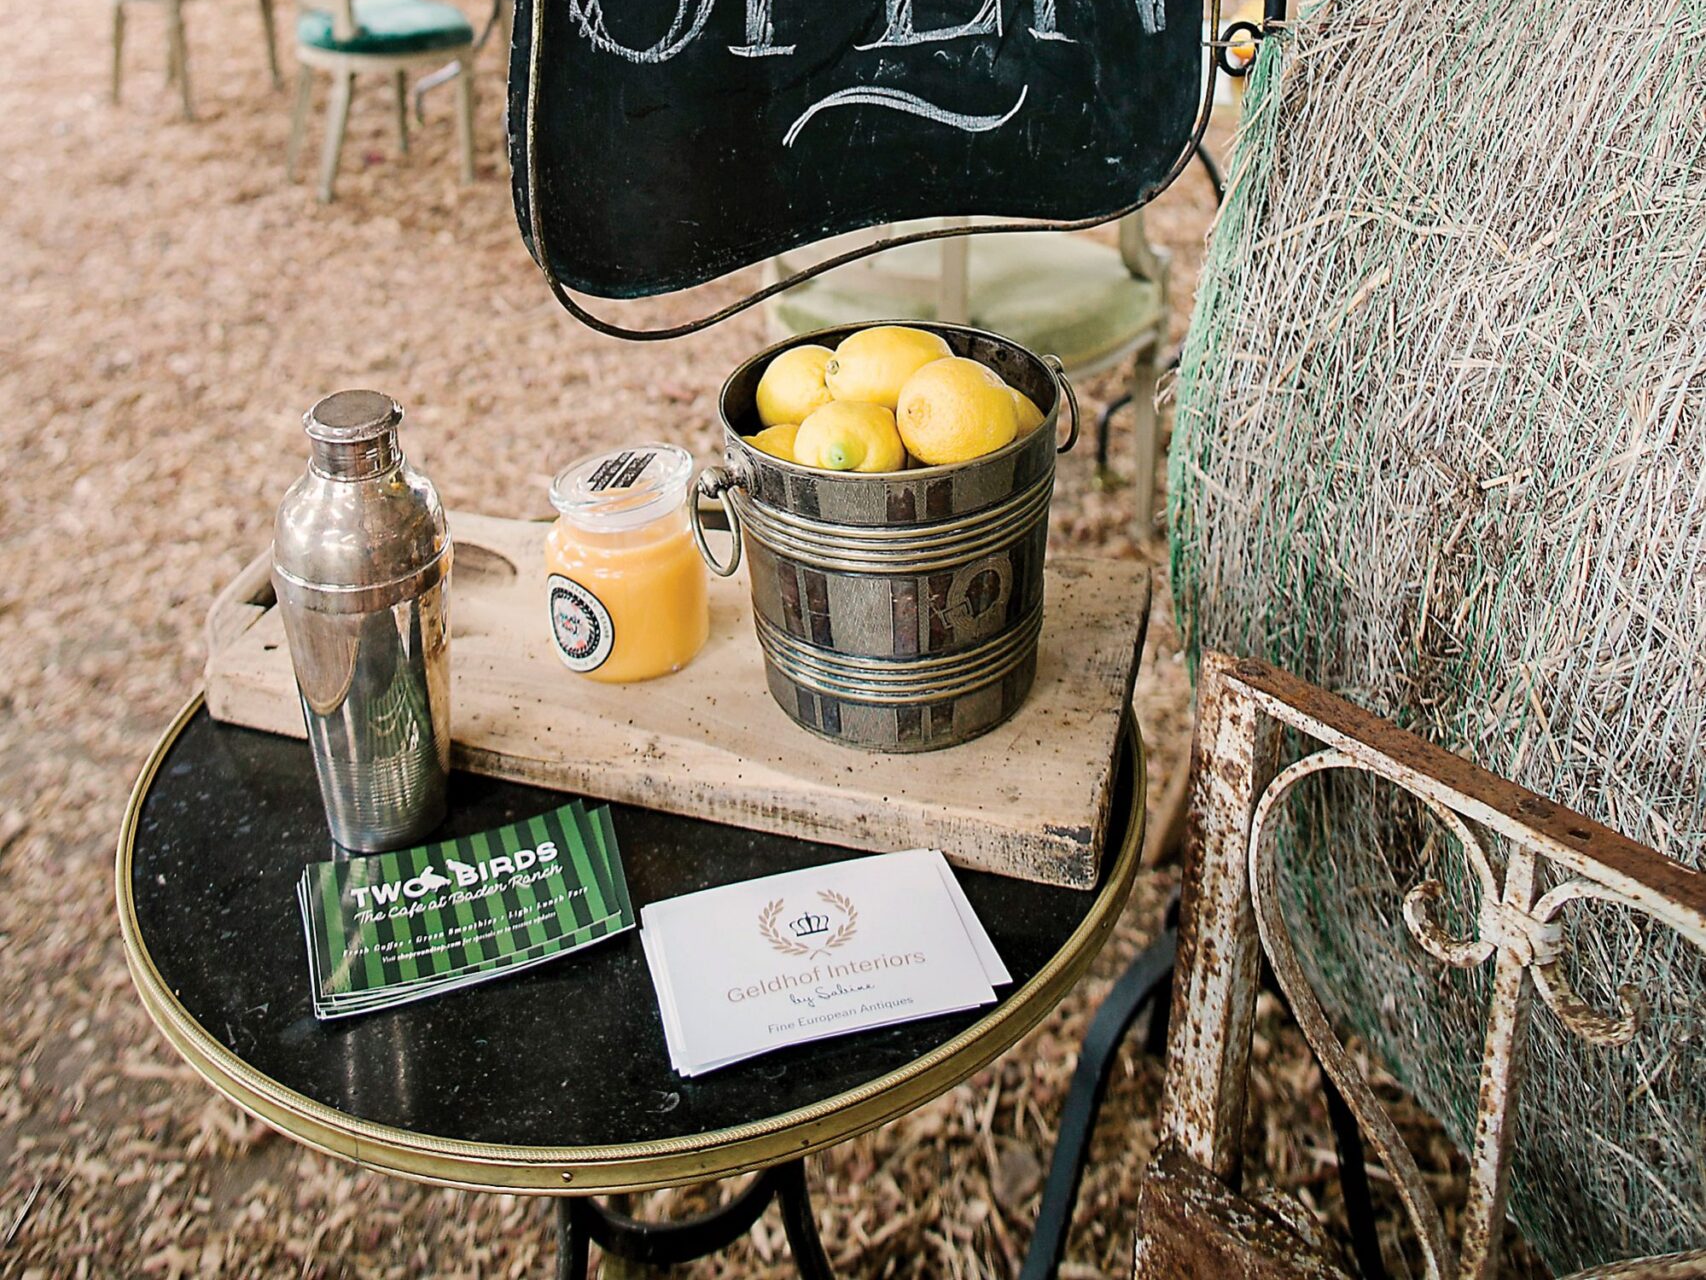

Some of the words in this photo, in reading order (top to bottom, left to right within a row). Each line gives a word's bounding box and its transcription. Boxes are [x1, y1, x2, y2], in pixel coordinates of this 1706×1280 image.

[350, 877, 433, 908] TWO
[454, 841, 558, 888] BIRDS
[354, 908, 386, 925] The
[388, 901, 426, 919] Cafe
[428, 895, 448, 910] at
[448, 883, 508, 905] Bader
[507, 863, 564, 889] Ranch
[374, 940, 404, 952] Coffee
[416, 932, 445, 944] Green
[508, 905, 533, 920] Light
[536, 894, 565, 910] Lunch
[727, 967, 820, 1004] Geldhof
[827, 951, 926, 979] Interiors
[789, 993, 815, 1008] by
[768, 1021, 795, 1034] Fine
[798, 1008, 857, 1027] European
[860, 996, 914, 1014] Antiques
